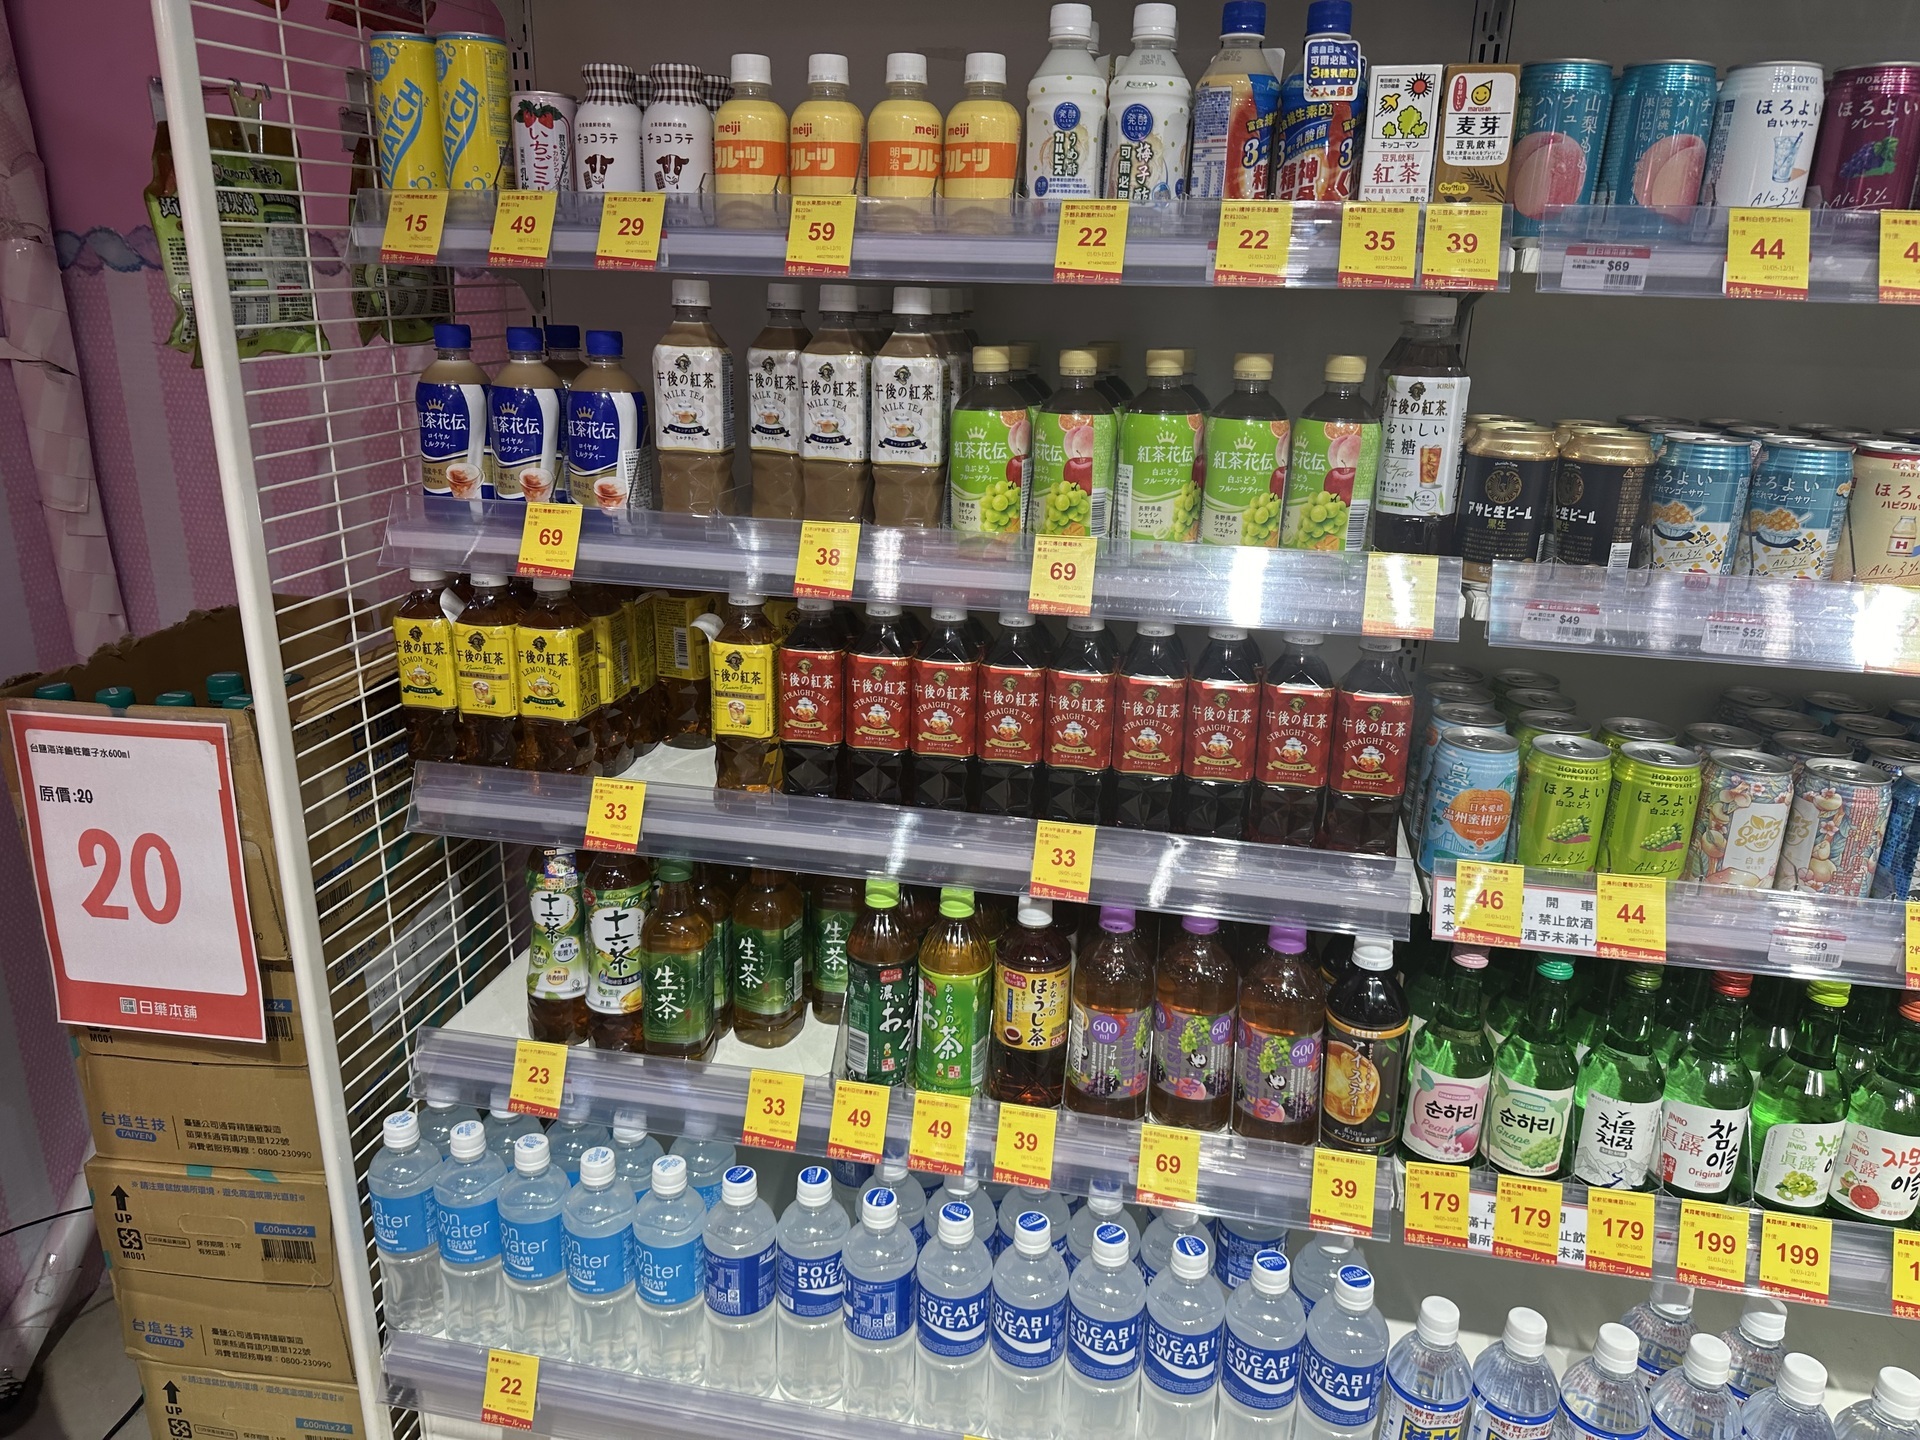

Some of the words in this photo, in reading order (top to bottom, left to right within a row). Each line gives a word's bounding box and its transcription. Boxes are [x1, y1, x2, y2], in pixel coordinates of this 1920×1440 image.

[1311, 56, 1347, 65] 可爾必思
[1058, 109, 1076, 120] 発酵
[1838, 101, 1919, 117] ほろよい
[718, 122, 741, 134] meiji
[792, 123, 812, 136] meiji
[1127, 114, 1148, 126] 発酵
[1456, 116, 1500, 135] 麦芽
[1767, 118, 1814, 128] 白いサワー
[1851, 118, 1899, 130] グレープ
[381, 78, 424, 183] MATCH
[577, 133, 618, 145] チョコラテ
[647, 133, 694, 145] チョコラテ
[915, 125, 939, 138] meiji
[948, 123, 969, 137] meiji
[1053, 132, 1065, 175] カルピス
[1456, 140, 1496, 149] 豆乳飲料
[890, 147, 899, 170] 明治
[1382, 154, 1414, 162] 豆乳飲料
[1373, 162, 1420, 184] 紅茶
[405, 215, 427, 231] 15
[511, 216, 535, 233] 49
[618, 217, 644, 236] 29
[808, 222, 835, 241] 59
[1078, 228, 1107, 247] 22
[1238, 230, 1269, 249] 22
[1364, 230, 1395, 250] 35
[1446, 233, 1478, 253] 39
[1751, 238, 1785, 260] 44
[1607, 261, 1629, 272] $69
[752, 391, 771, 402] MILK
[772, 392, 787, 404] TEA
[806, 399, 829, 410] MILK
[830, 399, 847, 412] TEA
[1390, 398, 1446, 416] 午後の紅茶
[881, 402, 904, 414] MILK
[907, 403, 924, 416] TEA
[1387, 421, 1445, 437] おいしい
[424, 440, 456, 448] ミルクティー
[1385, 439, 1416, 455] 無糖
[1137, 445, 1193, 464] 紅茶花伝
[1213, 451, 1274, 471] 紅茶花伝
[960, 474, 999, 483] フルーツティー
[1143, 476, 1186, 486] フルーツティー
[1228, 475, 1257, 485] 白ぶどう
[1218, 484, 1264, 494] フルーツティー
[1468, 501, 1532, 520] アサヒ生ビール
[1138, 518, 1163, 526] マスカット
[539, 528, 563, 546] 69
[816, 547, 840, 567] 38
[1050, 562, 1076, 581] 69
[1559, 614, 1580, 625] $49
[400, 656, 422, 666] LEMON
[423, 656, 439, 669] TEA
[521, 666, 546, 678] LEMON
[547, 668, 562, 680] TEA
[1342, 717, 1406, 737] 午後の紅茶
[1342, 737, 1382, 752] STRAIGHT
[1384, 740, 1400, 756] TEA
[1558, 766, 1598, 774] HOROYOI
[1652, 773, 1692, 782] HOROYOI
[40, 785, 93, 803] 原價:20
[604, 802, 627, 821] 33
[1469, 803, 1504, 813] 日本愛媛
[1555, 799, 1592, 809] 白ぶどう
[1650, 807, 1685, 817] 白ぶどう
[1051, 848, 1076, 867] 33
[1745, 856, 1765, 866] 白桃
[78, 828, 182, 925] 20
[624, 896, 638, 907] 16
[1475, 890, 1503, 910] 46
[1546, 897, 1559, 908] 開
[1581, 900, 1594, 911] 車
[540, 894, 566, 943] 十六茶
[1617, 904, 1646, 924] 44
[604, 910, 637, 975] 十六茶
[738, 936, 762, 990] 生茶
[654, 965, 684, 1020] 生茶
[879, 984, 904, 1002] 濃い
[139, 1000, 198, 1020] 日藥本舖
[944, 984, 954, 1023] あなたの
[1027, 979, 1048, 1046] ほうじ茶
[1092, 1022, 1118, 1033] 600
[89, 1032, 114, 1044] M001
[933, 1025, 963, 1060] 茶
[528, 1067, 550, 1084] 23
[1350, 1039, 1366, 1118] アイスティー
[762, 1096, 785, 1116] 33
[1425, 1101, 1478, 1122] 순하리
[102, 1112, 166, 1132] 台塩生技
[848, 1108, 871, 1128] 49
[1421, 1118, 1455, 1135] Peach
[1500, 1107, 1555, 1135] 순하리
[1598, 1112, 1636, 1135] 처음
[119, 1129, 153, 1140] TAIYEN
[928, 1119, 951, 1139] 49
[1495, 1125, 1530, 1146] Grape
[1707, 1119, 1737, 1150] 참
[1014, 1132, 1038, 1152] 39
[1596, 1128, 1633, 1150] 처럼
[1786, 1142, 1807, 1151] JINRO
[1850, 1142, 1870, 1156] JINRO
[1156, 1153, 1181, 1174] 69
[1688, 1167, 1723, 1178] Original
[1843, 1154, 1880, 1179] 眞露
[1331, 1178, 1357, 1199] 39
[1420, 1191, 1460, 1213] 179
[115, 1213, 132, 1224] UP
[1510, 1206, 1551, 1229] 179
[1602, 1218, 1644, 1241] 179
[1694, 1230, 1736, 1254] 199
[122, 1251, 146, 1262] M001
[1776, 1243, 1819, 1267] 199
[132, 1318, 194, 1339] 台塩生技
[149, 1336, 181, 1347] TAIYEN
[1228, 1337, 1296, 1368] POCARI
[1226, 1351, 1288, 1380] SWEAT
[500, 1376, 522, 1396] 22
[165, 1406, 182, 1416] UP
